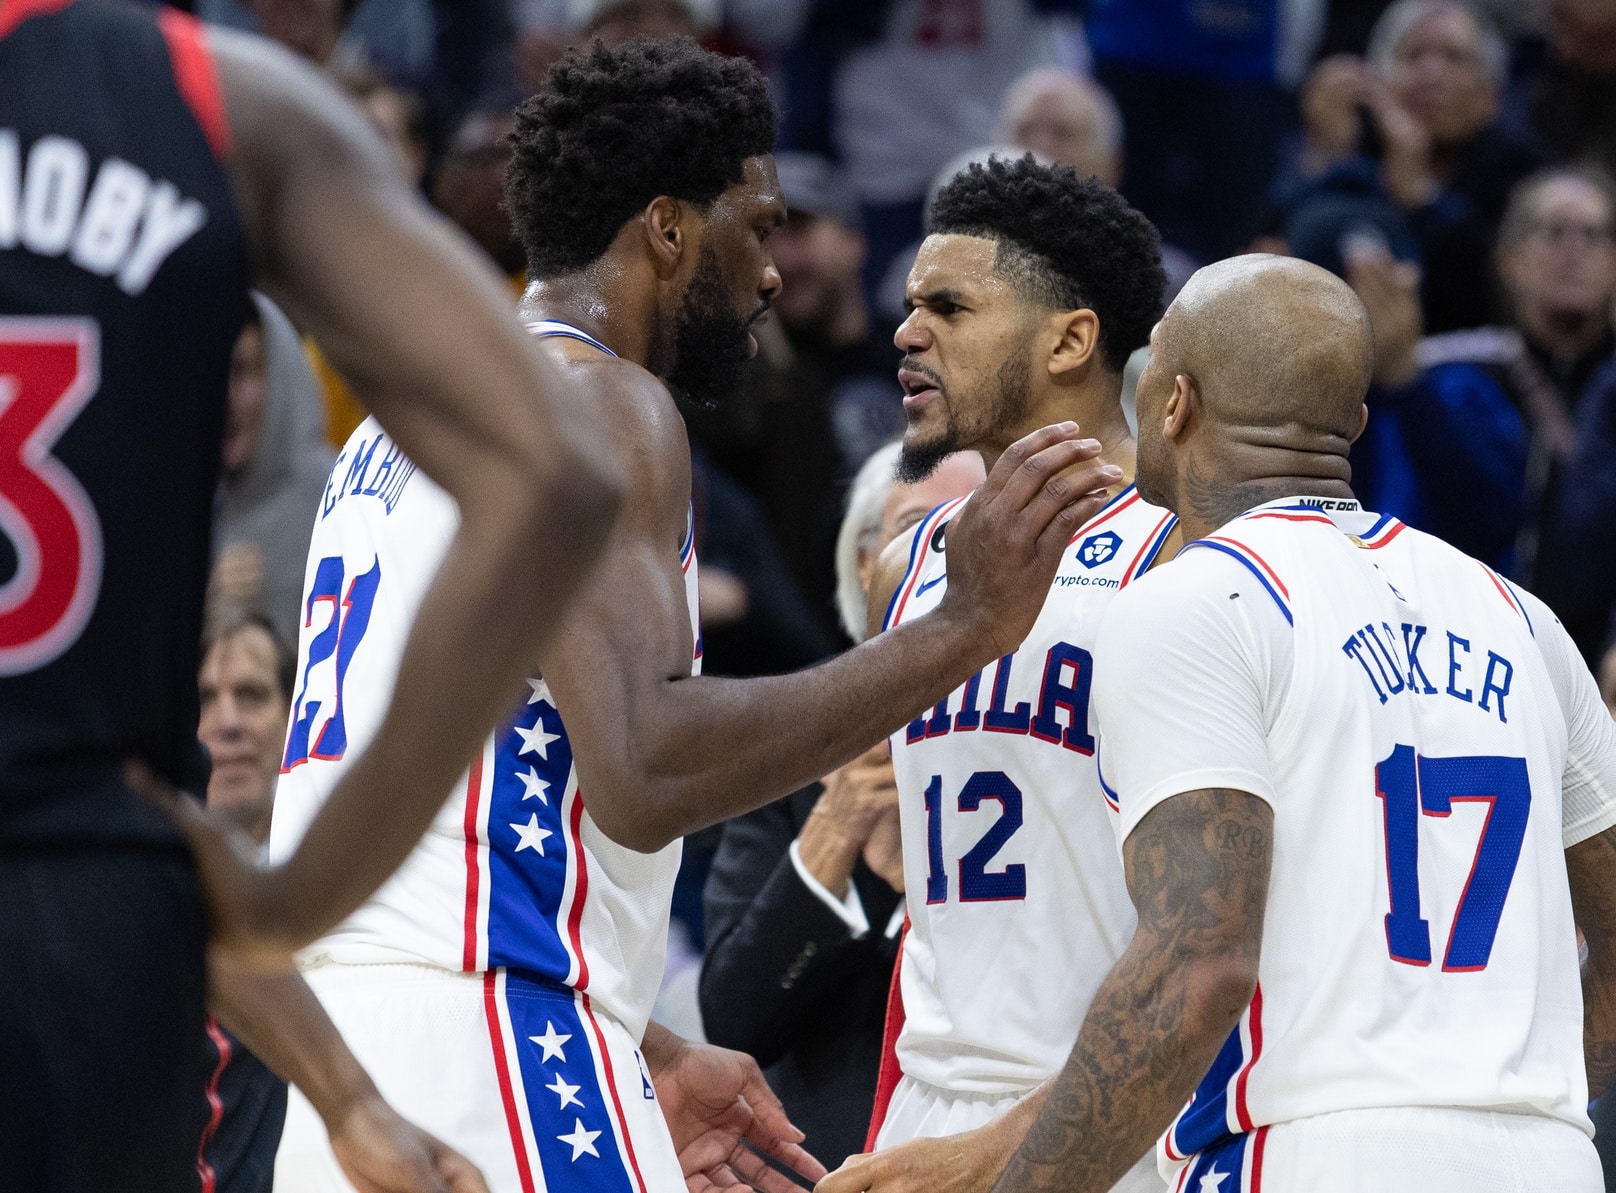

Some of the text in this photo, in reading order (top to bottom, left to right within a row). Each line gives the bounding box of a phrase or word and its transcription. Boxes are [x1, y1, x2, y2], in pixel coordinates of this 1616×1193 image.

[279, 552, 382, 774] 21
[1054, 574, 1119, 588] rypto.com
[924, 771, 1026, 905] 12
[1375, 743, 1532, 973] 17
